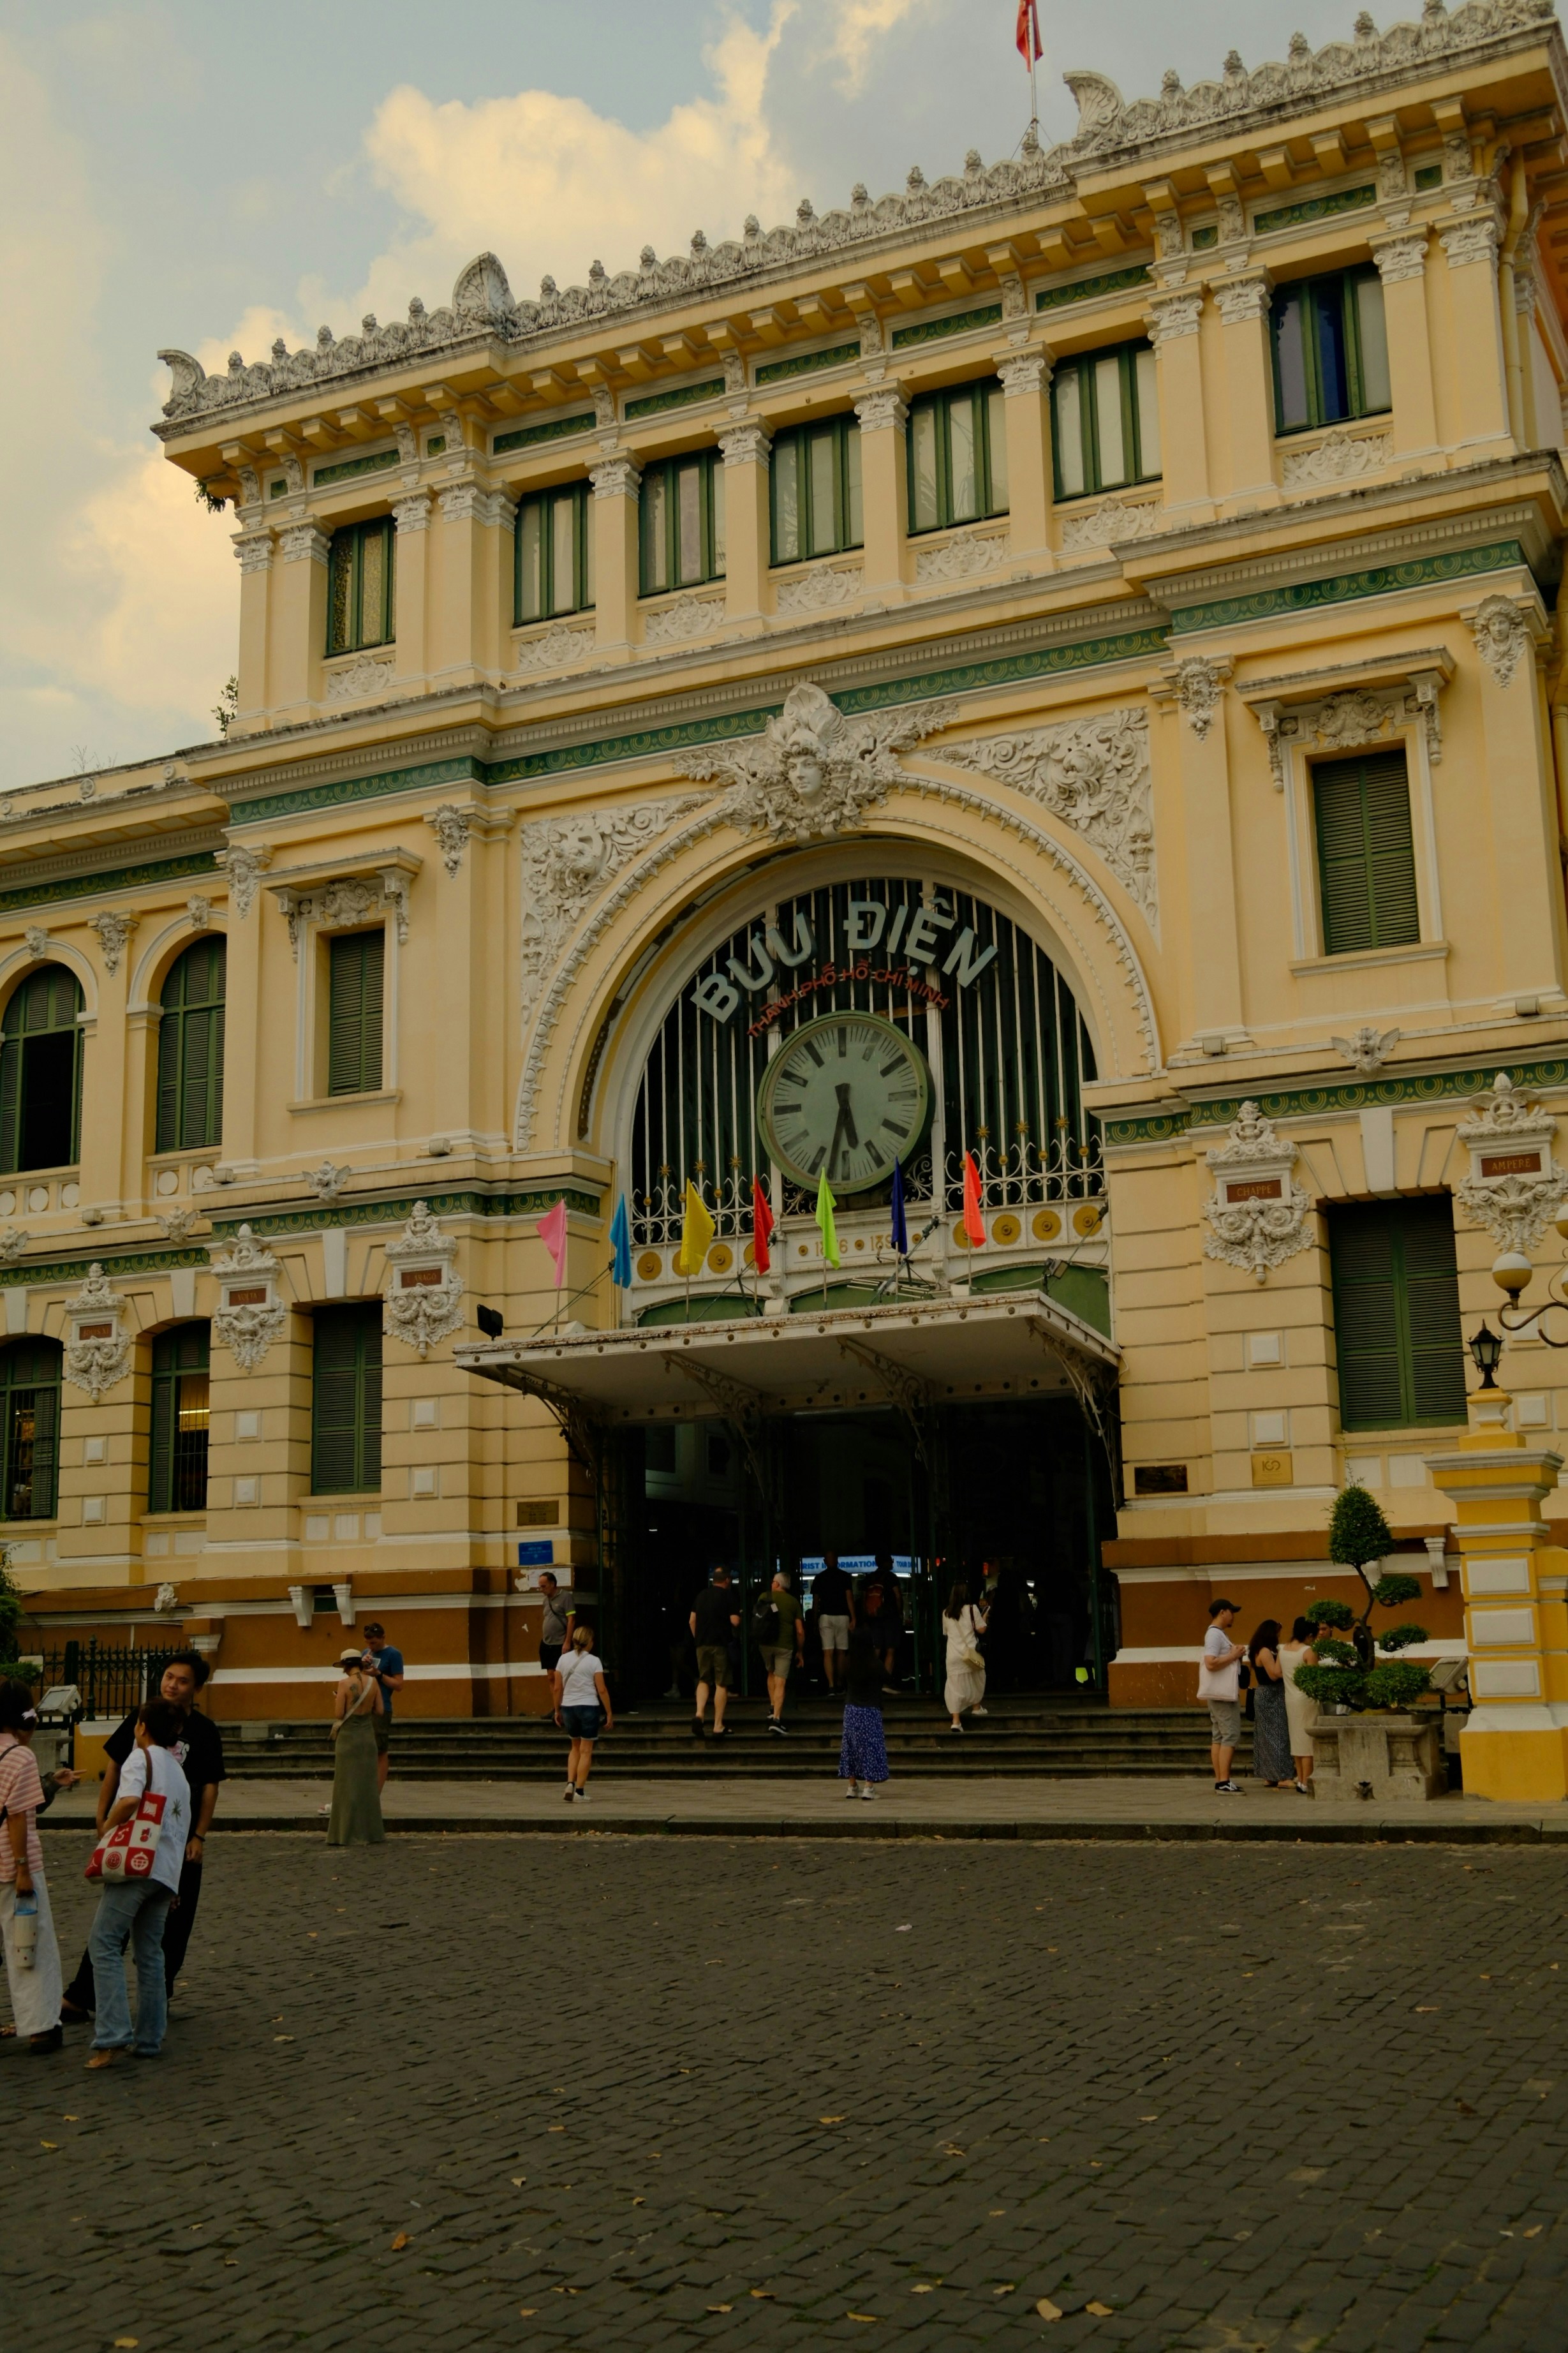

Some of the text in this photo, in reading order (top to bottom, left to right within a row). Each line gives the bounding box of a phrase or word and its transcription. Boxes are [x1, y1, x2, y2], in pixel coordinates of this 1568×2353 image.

[690, 896, 998, 1023] BƯU ĐIỆN
[800, 961, 837, 997] PHỐ
[842, 957, 869, 981] HỒ
[875, 965, 909, 987] CHÍ
[905, 977, 950, 1011] MINH
[1491, 1158, 1531, 1171] AMPERE
[1236, 1185, 1272, 1197] CHAPPE
